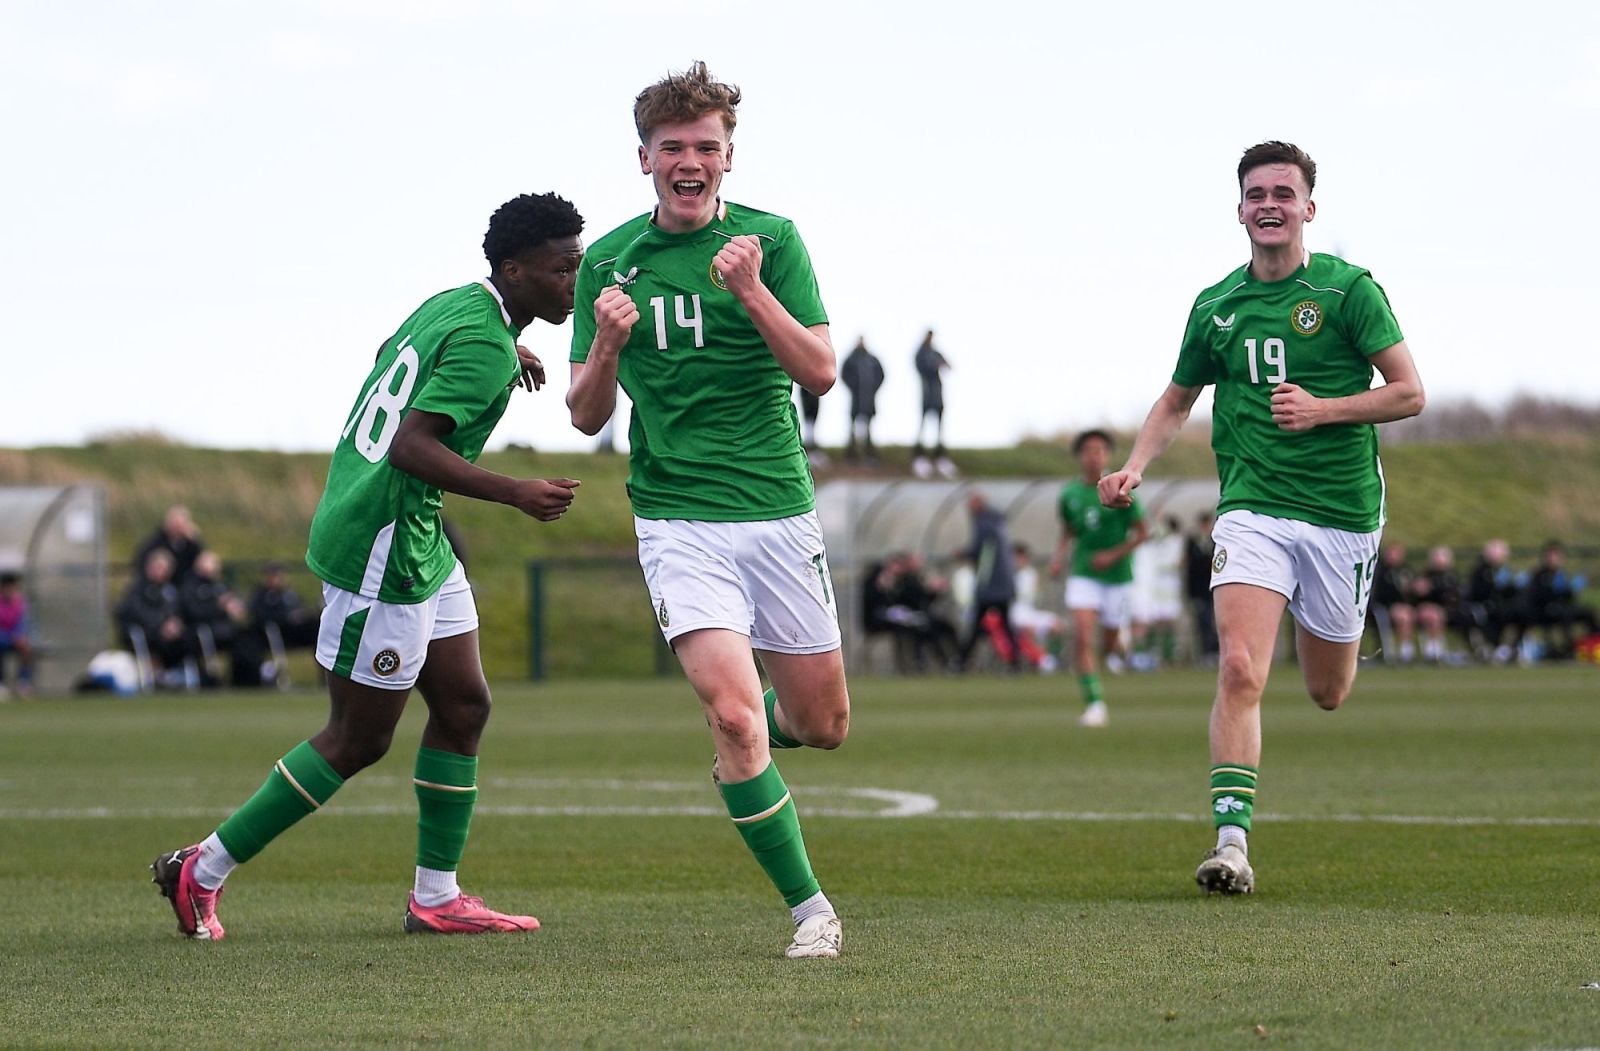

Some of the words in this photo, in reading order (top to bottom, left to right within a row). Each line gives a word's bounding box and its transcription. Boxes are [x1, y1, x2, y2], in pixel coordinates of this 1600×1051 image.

[649, 294, 704, 350] 14
[1244, 337, 1287, 384] 19
[342, 334, 420, 463] 18
[812, 549, 831, 604] 1
